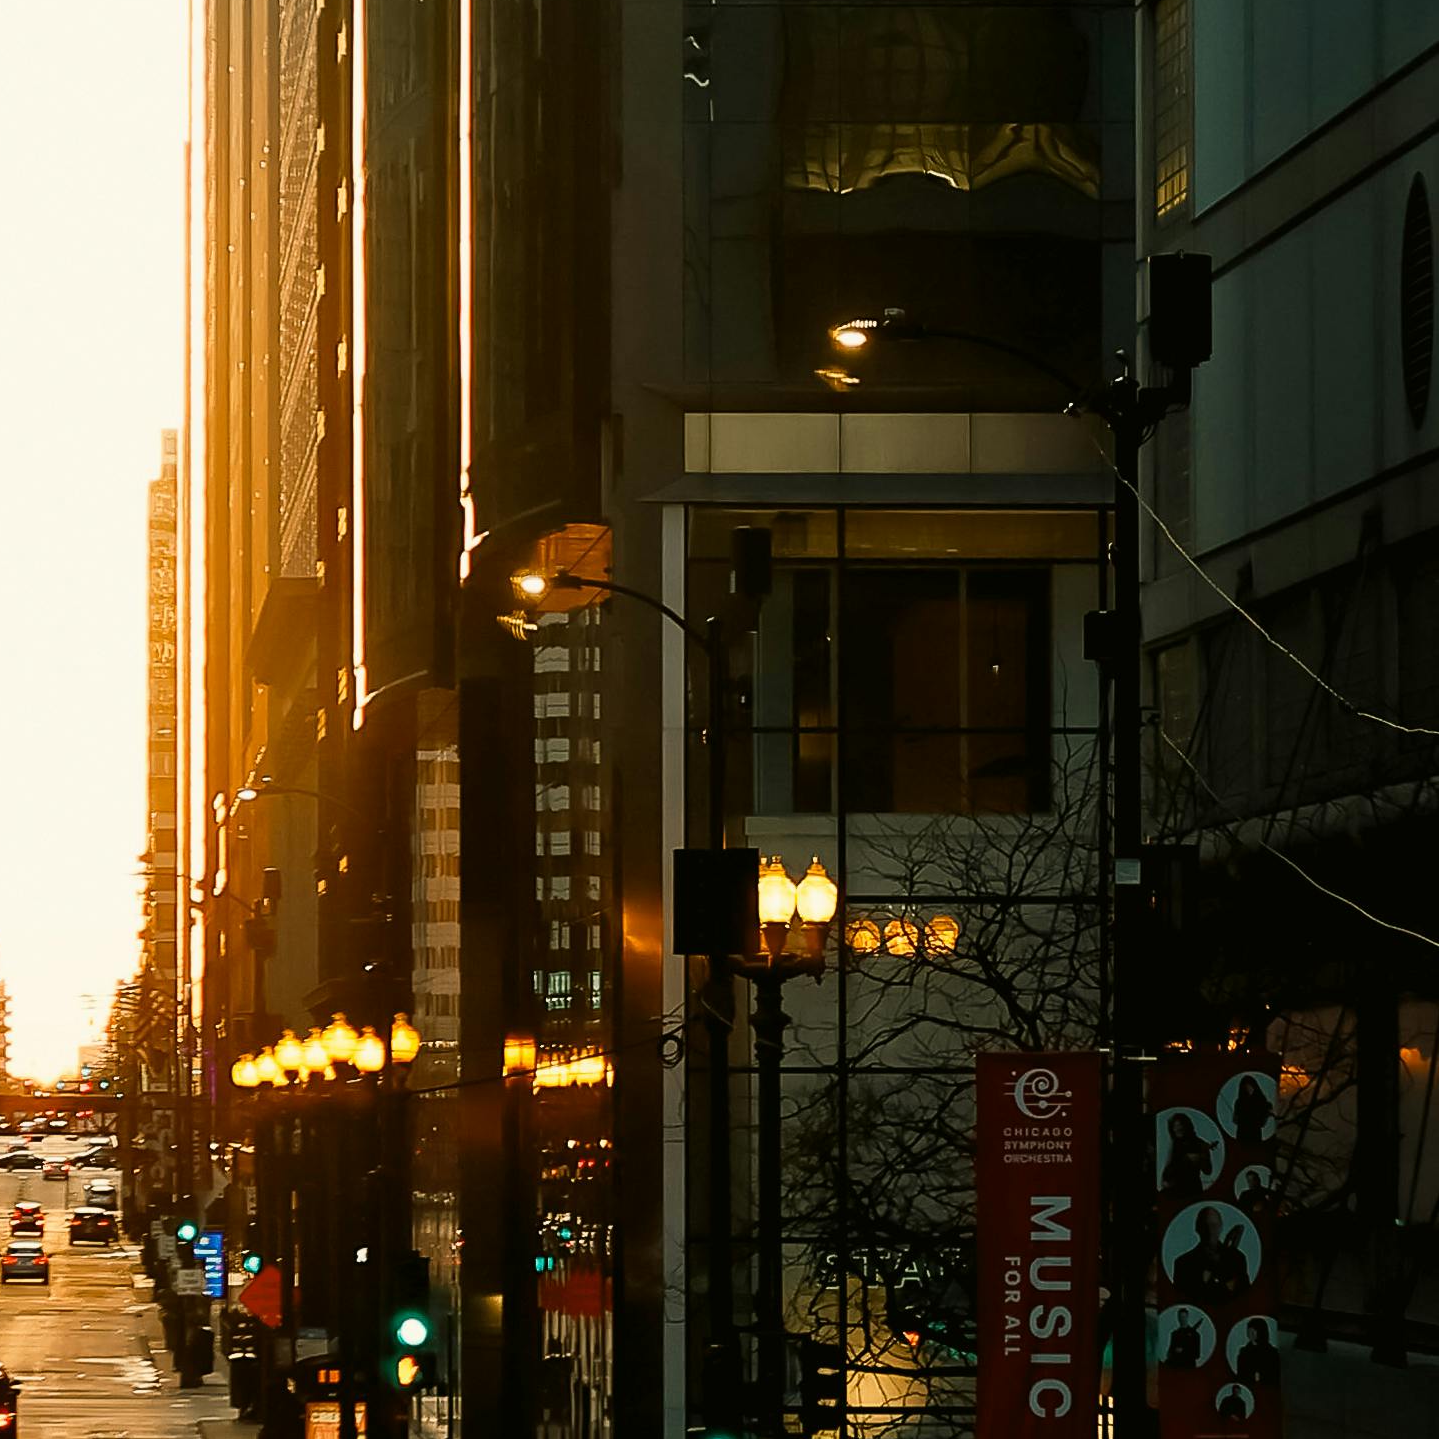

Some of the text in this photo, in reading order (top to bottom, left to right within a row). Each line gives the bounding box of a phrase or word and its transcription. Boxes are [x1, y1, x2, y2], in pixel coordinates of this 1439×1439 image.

[1003, 1127, 1073, 1137] CHICAGO
[1003, 1140, 1072, 1150] SYMPHONY
[1003, 1154, 1073, 1163] ORCHESTRA
[1004, 1256, 1021, 1356] FOR ALL
[1028, 1195, 1072, 1419] MUSIC
